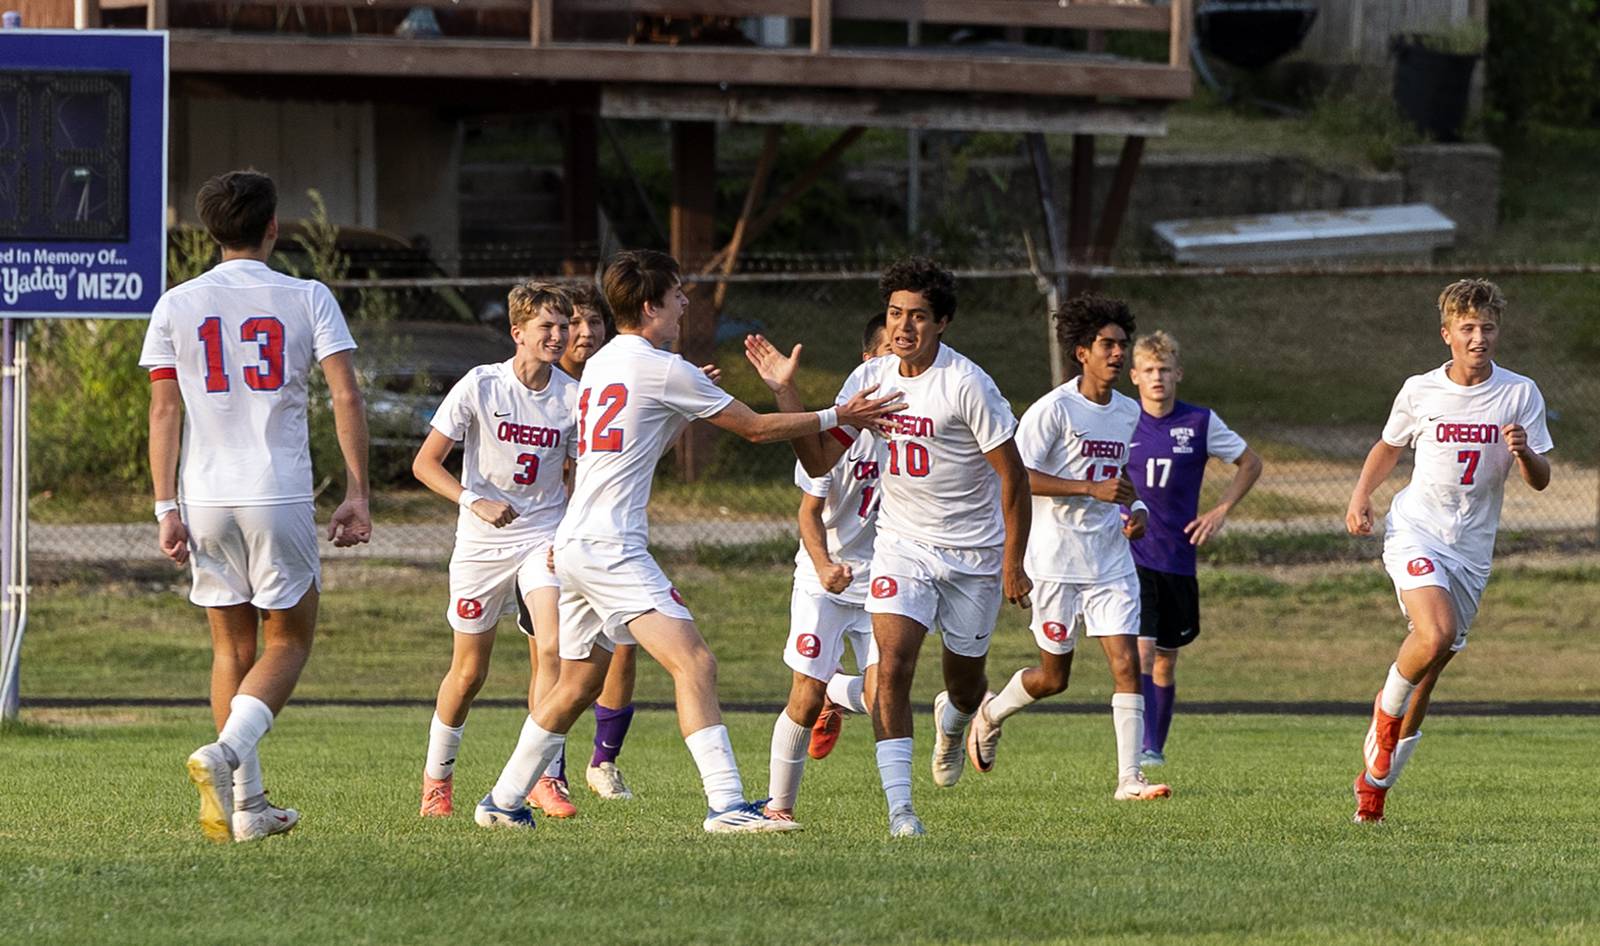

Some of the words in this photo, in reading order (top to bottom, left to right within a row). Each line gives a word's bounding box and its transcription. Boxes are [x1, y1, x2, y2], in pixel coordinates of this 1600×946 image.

[17, 248, 31, 263] In
[34, 249, 95, 268] Memory
[98, 249, 127, 264] Of...
[77, 272, 143, 301] MEZO
[198, 316, 285, 393] 13
[497, 421, 561, 449] OREGON
[578, 383, 629, 457] 12
[1436, 423, 1499, 444] OREGON
[888, 440, 930, 477] 10
[1081, 440, 1125, 459] OREGON
[513, 453, 540, 486] 3
[1146, 458, 1172, 488] 17
[1457, 450, 1481, 485] 7
